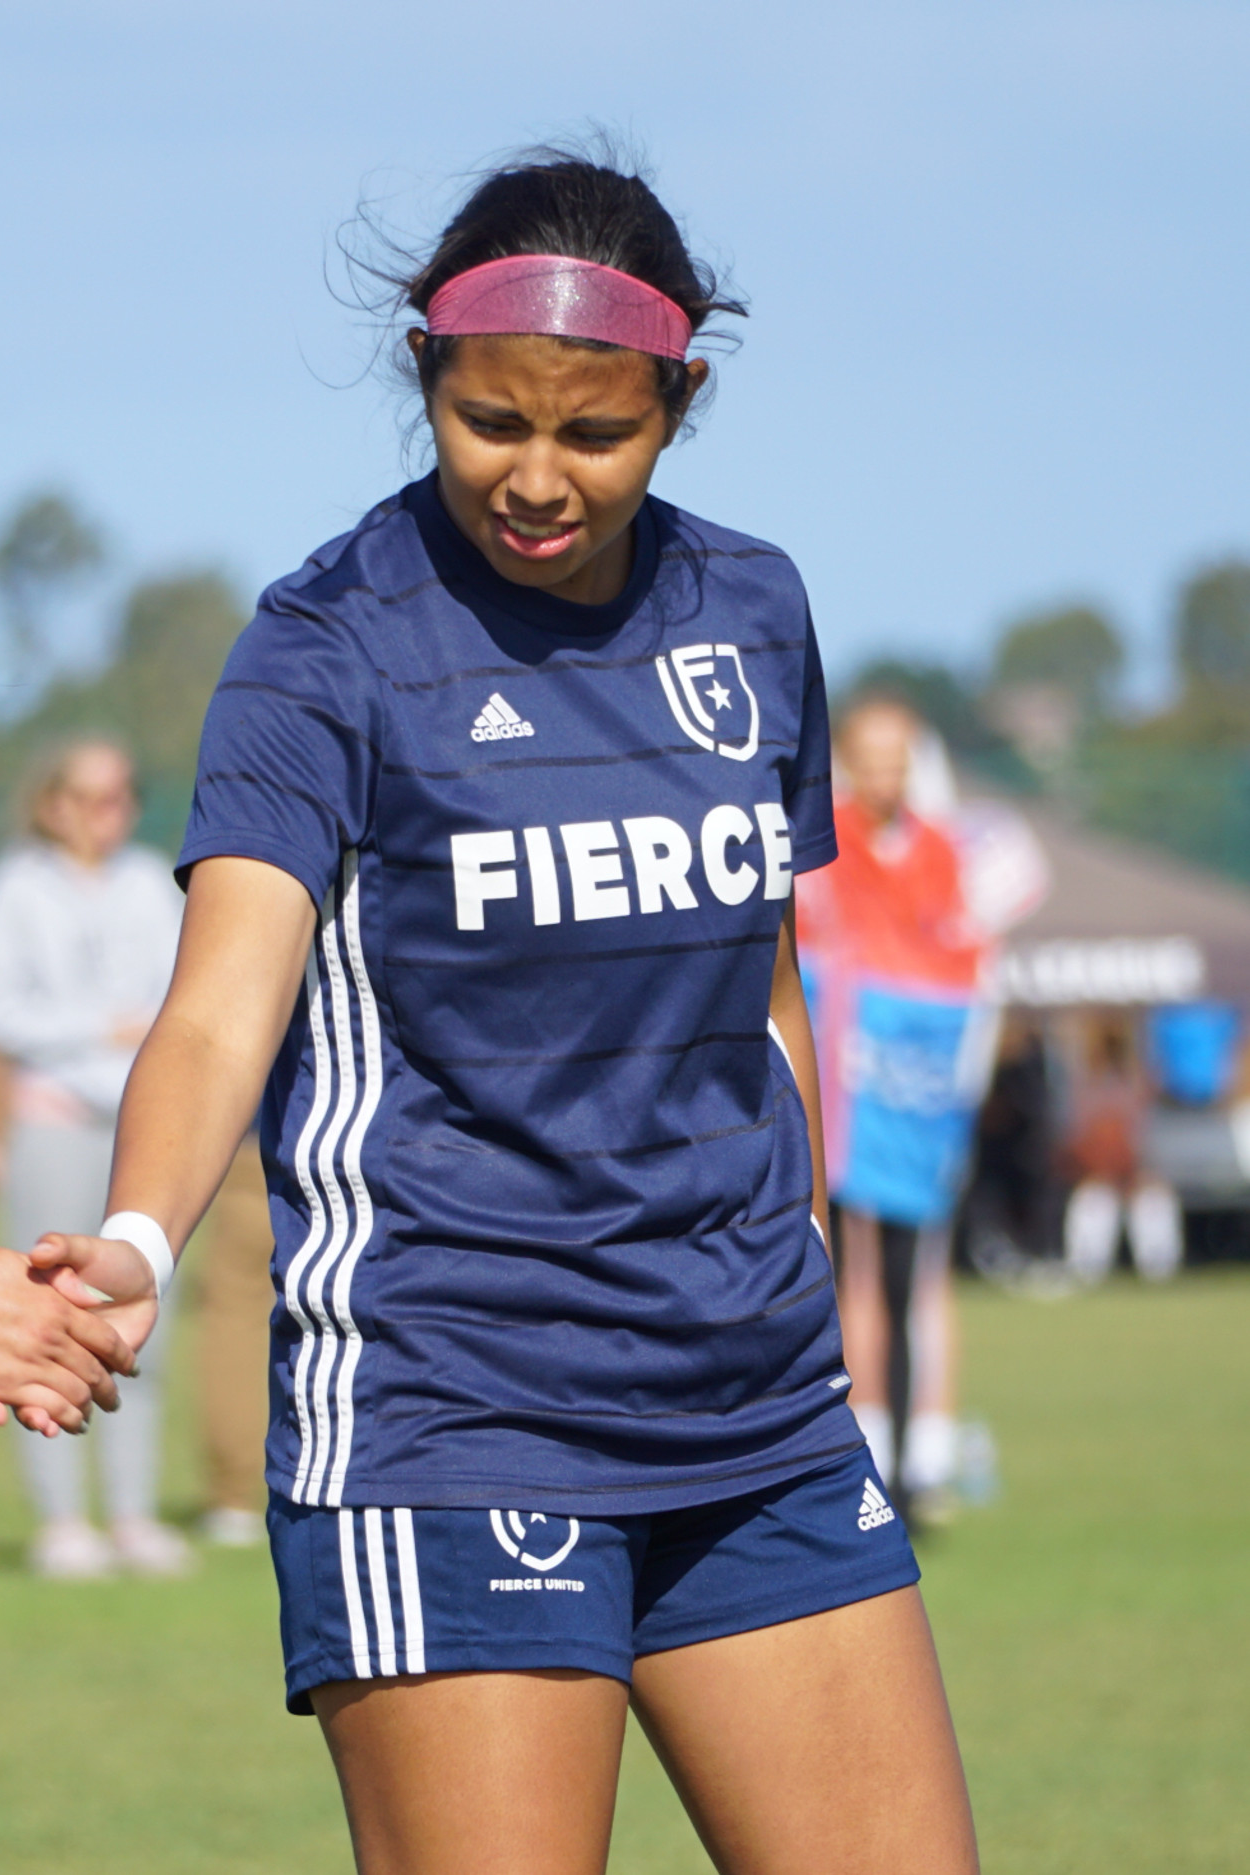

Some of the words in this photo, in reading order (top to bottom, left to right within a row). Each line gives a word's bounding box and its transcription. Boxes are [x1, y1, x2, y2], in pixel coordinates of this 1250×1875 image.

[470, 720, 535, 743] adidas
[450, 802, 793, 931] FIERCE
[489, 1578, 543, 1592] FIERCE
[544, 1578, 585, 1592] UNITED
